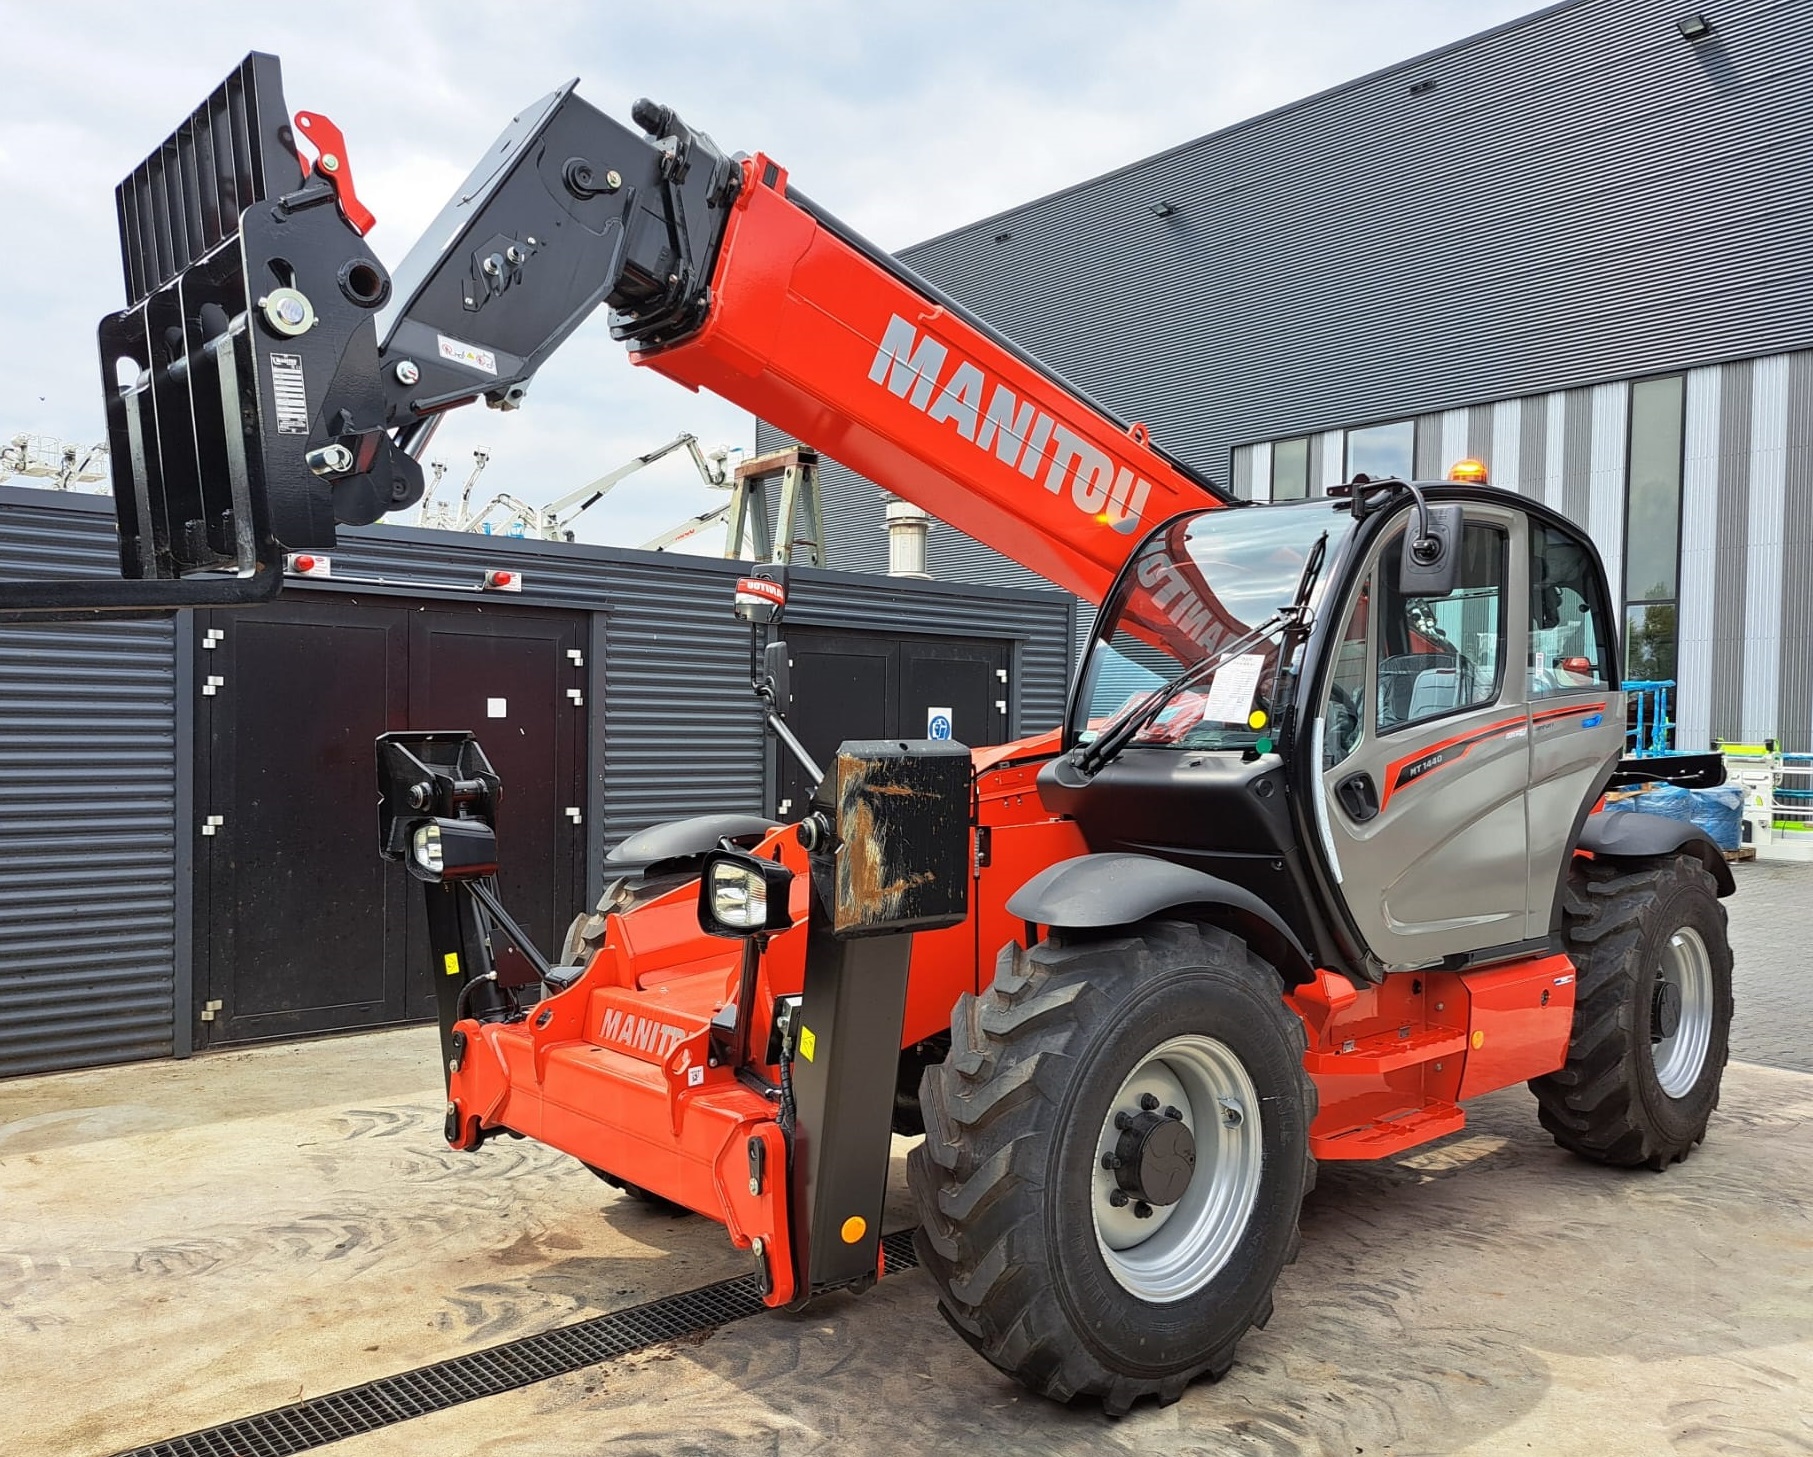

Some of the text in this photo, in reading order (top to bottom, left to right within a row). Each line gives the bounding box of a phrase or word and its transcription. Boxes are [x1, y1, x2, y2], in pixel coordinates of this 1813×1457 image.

[868, 312, 1152, 535] MANITOU
[1410, 754, 1443, 777] MT 1440
